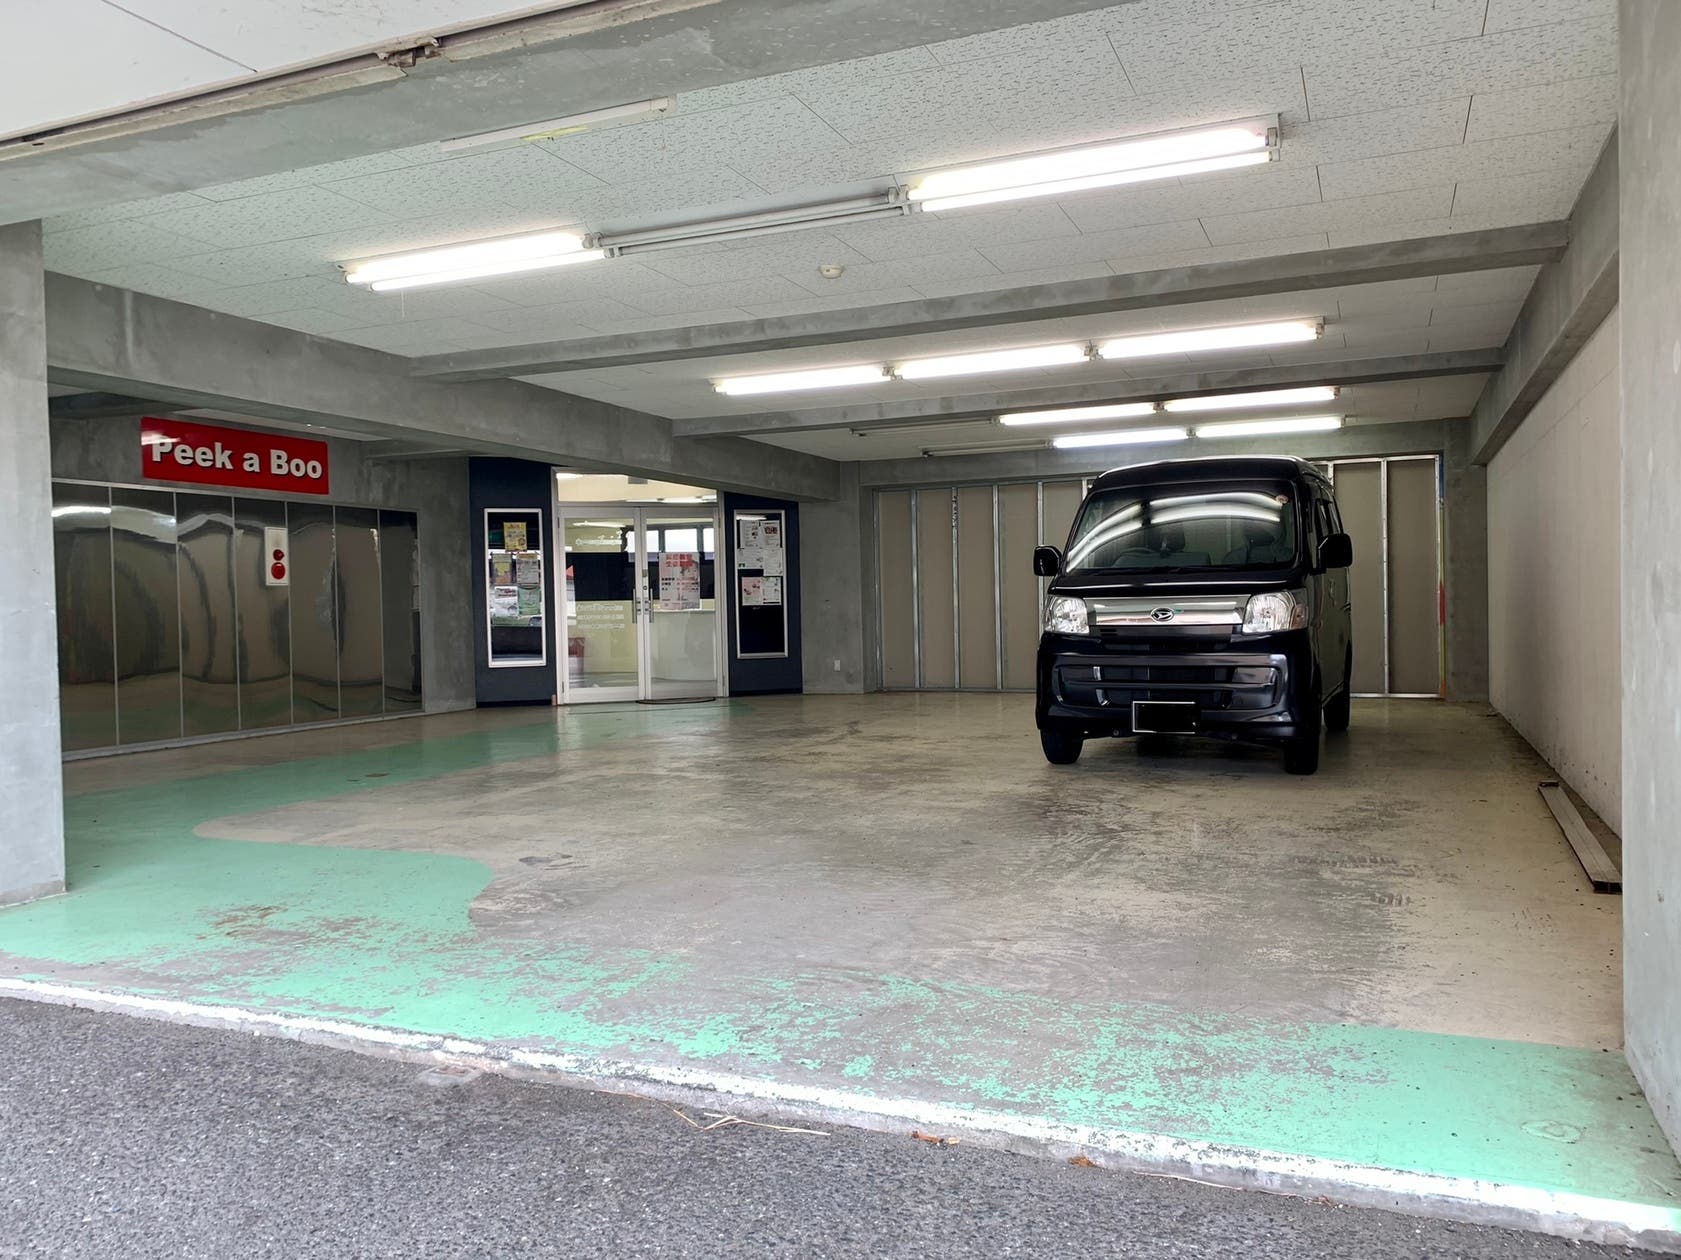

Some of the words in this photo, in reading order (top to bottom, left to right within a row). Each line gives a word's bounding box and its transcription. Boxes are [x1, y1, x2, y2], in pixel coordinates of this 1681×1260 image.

[152, 438, 233, 469] Peek
[242, 452, 260, 473] a
[270, 449, 322, 479] Boo
